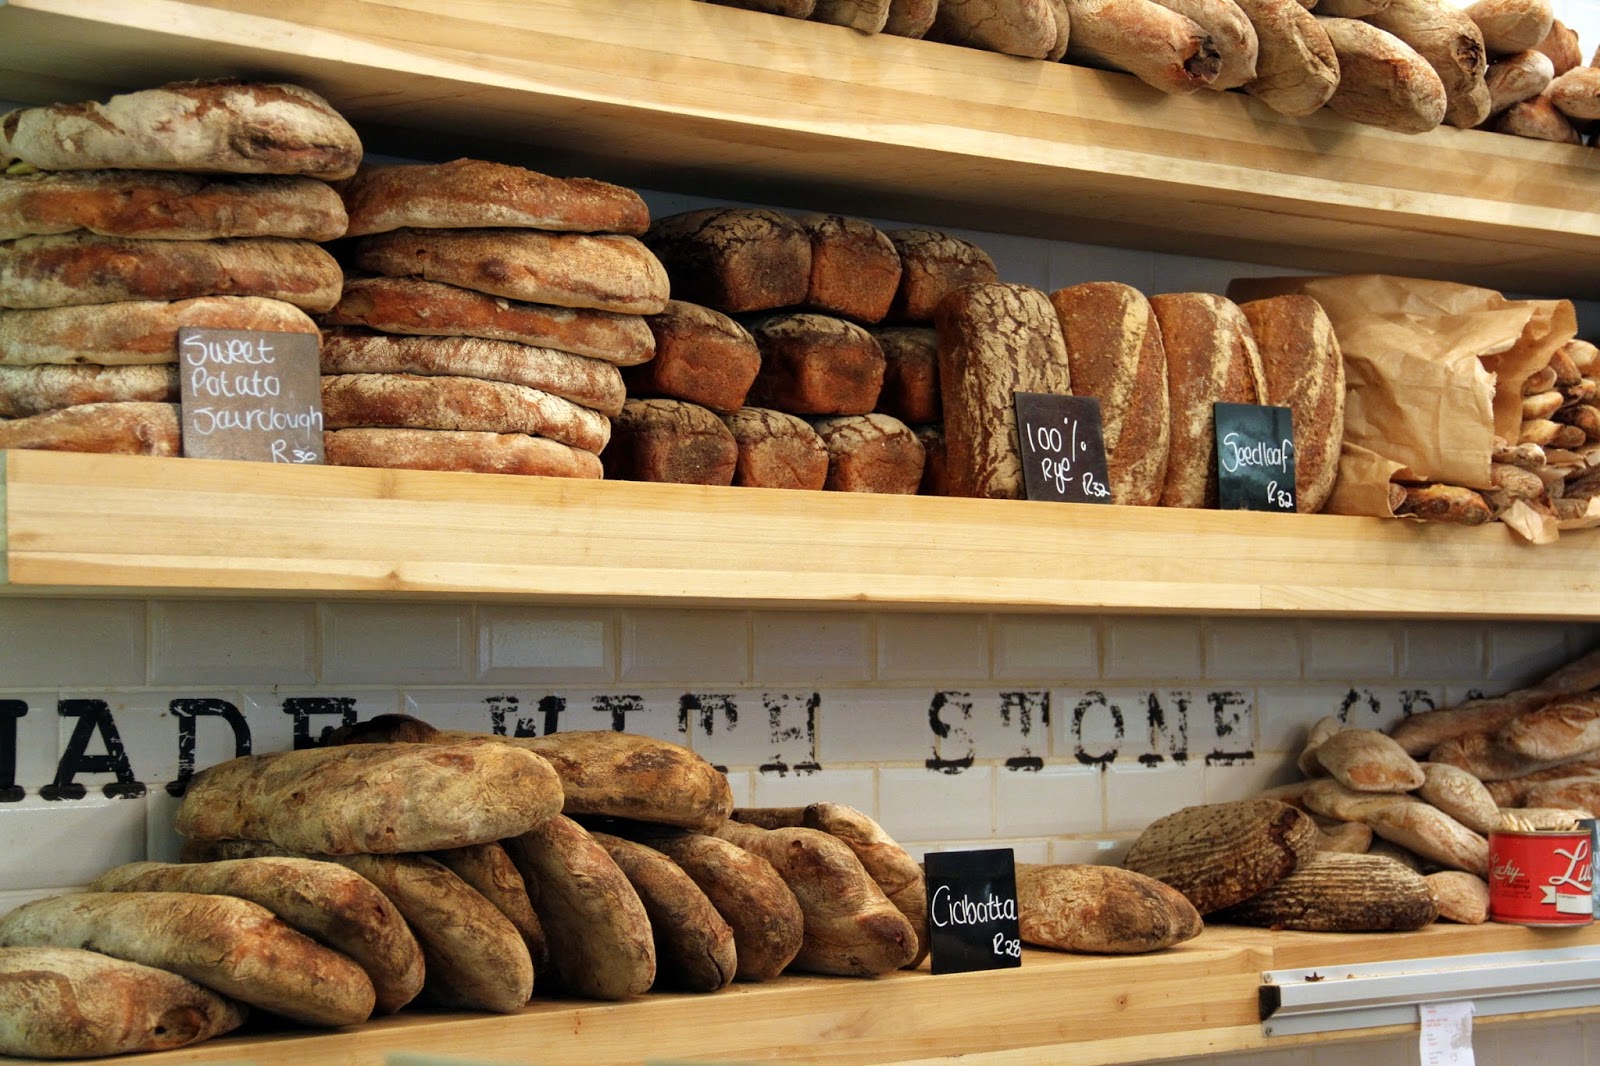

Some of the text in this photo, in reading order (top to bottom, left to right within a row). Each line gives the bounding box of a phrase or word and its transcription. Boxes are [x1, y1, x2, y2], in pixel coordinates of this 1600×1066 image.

[183, 335, 275, 366] Sweet
[191, 367, 280, 397] Potato
[193, 405, 324, 440] Sourdough
[1027, 417, 1087, 462] 100%
[1222, 432, 1293, 473] Seedloaf
[1041, 457, 1074, 493] Rye
[1082, 472, 1110, 497] R32
[1267, 480, 1293, 508] R32
[925, 690, 1254, 775] STONE
[932, 885, 1018, 927] Ciabatta
[993, 932, 1021, 957] R28
